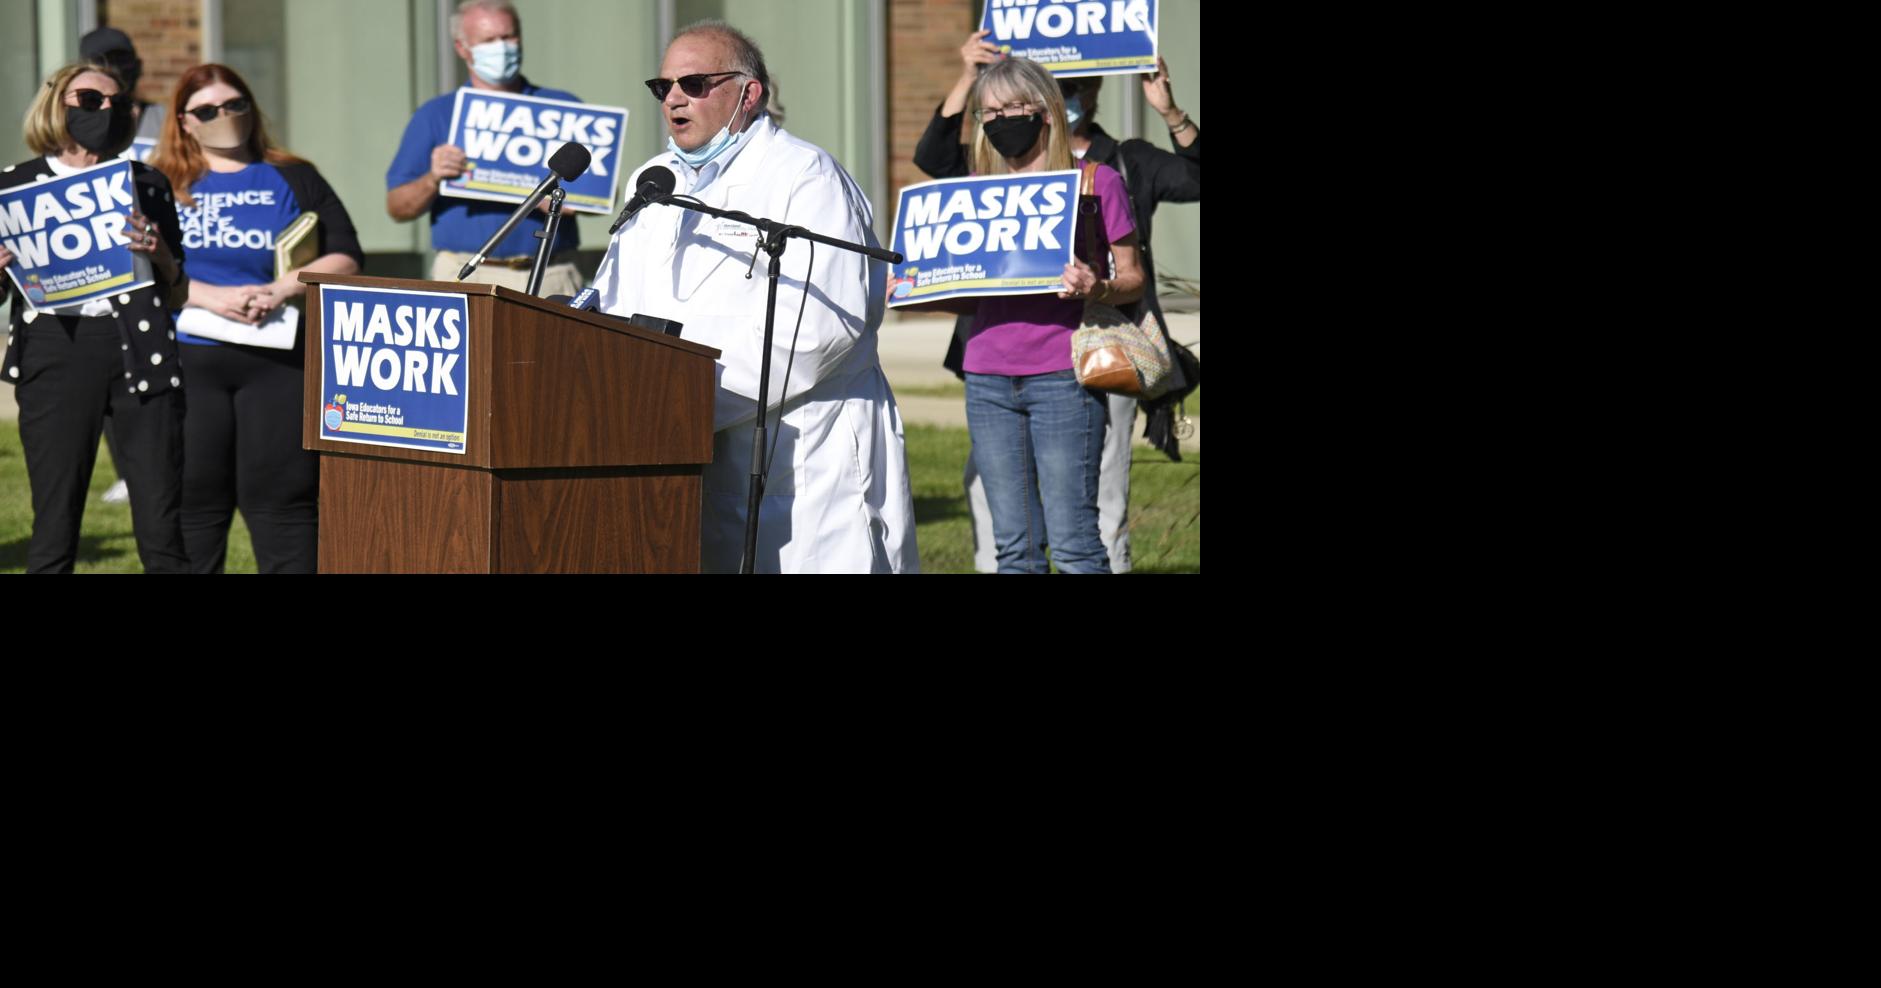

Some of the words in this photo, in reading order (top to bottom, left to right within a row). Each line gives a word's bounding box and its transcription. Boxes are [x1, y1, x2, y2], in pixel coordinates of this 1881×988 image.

[992, 0, 1148, 41] WORK
[464, 100, 617, 147] MASKS
[0, 170, 133, 237] MASK
[192, 190, 275, 208] CIENCE
[905, 182, 1067, 229] MASKS
[3, 208, 132, 269] WOR
[181, 229, 275, 250] CHOOL
[904, 216, 1064, 262] WORK
[961, 270, 986, 280] School
[965, 263, 976, 272] for
[976, 264, 982, 272] a
[332, 301, 460, 350] MASKS
[332, 344, 460, 396] WORK
[346, 411, 359, 421] Safe
[359, 412, 377, 423] Return
[377, 413, 384, 424] to
[385, 414, 404, 426] School
[360, 402, 387, 415] Educators
[388, 405, 396, 416] for
[396, 407, 401, 415] a
